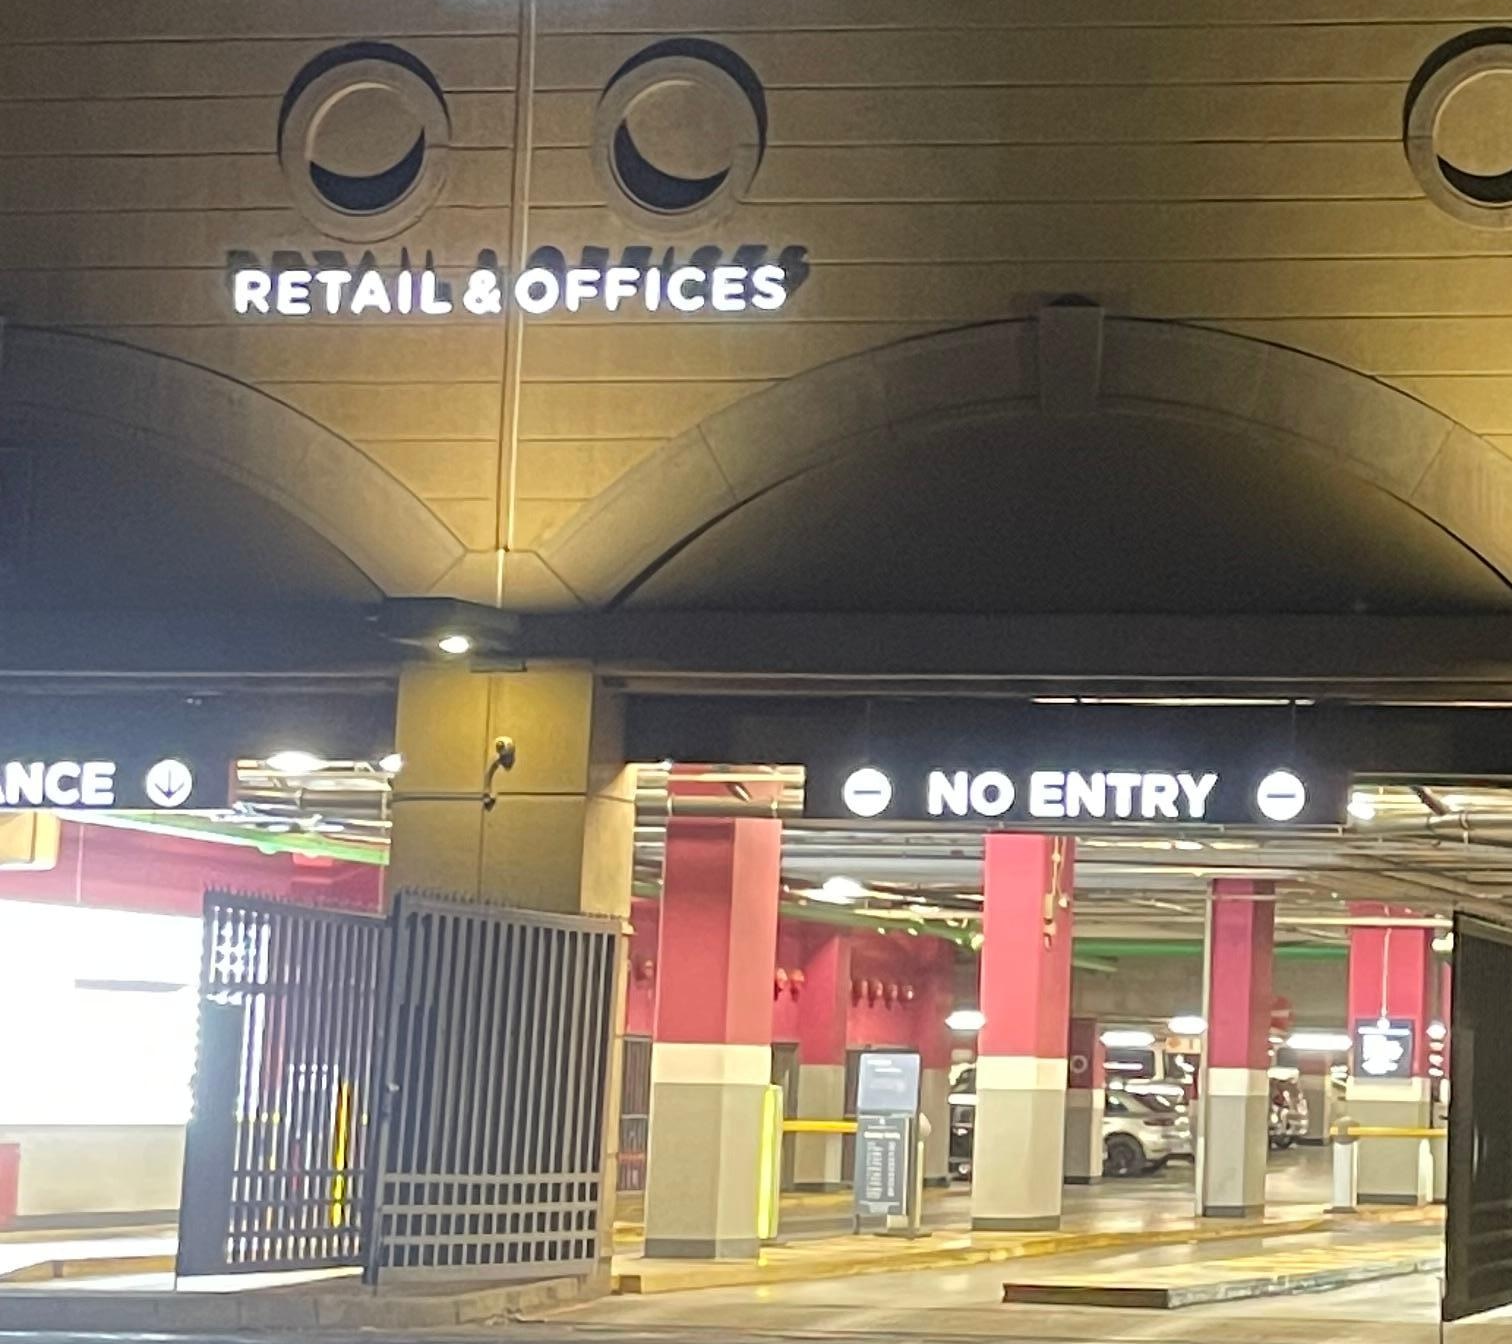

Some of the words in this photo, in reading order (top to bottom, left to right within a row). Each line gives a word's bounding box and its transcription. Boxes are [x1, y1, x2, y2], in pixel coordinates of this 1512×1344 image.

[233, 269, 453, 315] RETAIL
[462, 269, 502, 315] &
[513, 264, 788, 314] OFFICES
[0, 760, 116, 805] NCE
[927, 770, 1015, 816] NO
[1028, 770, 1219, 818] ENTRY
